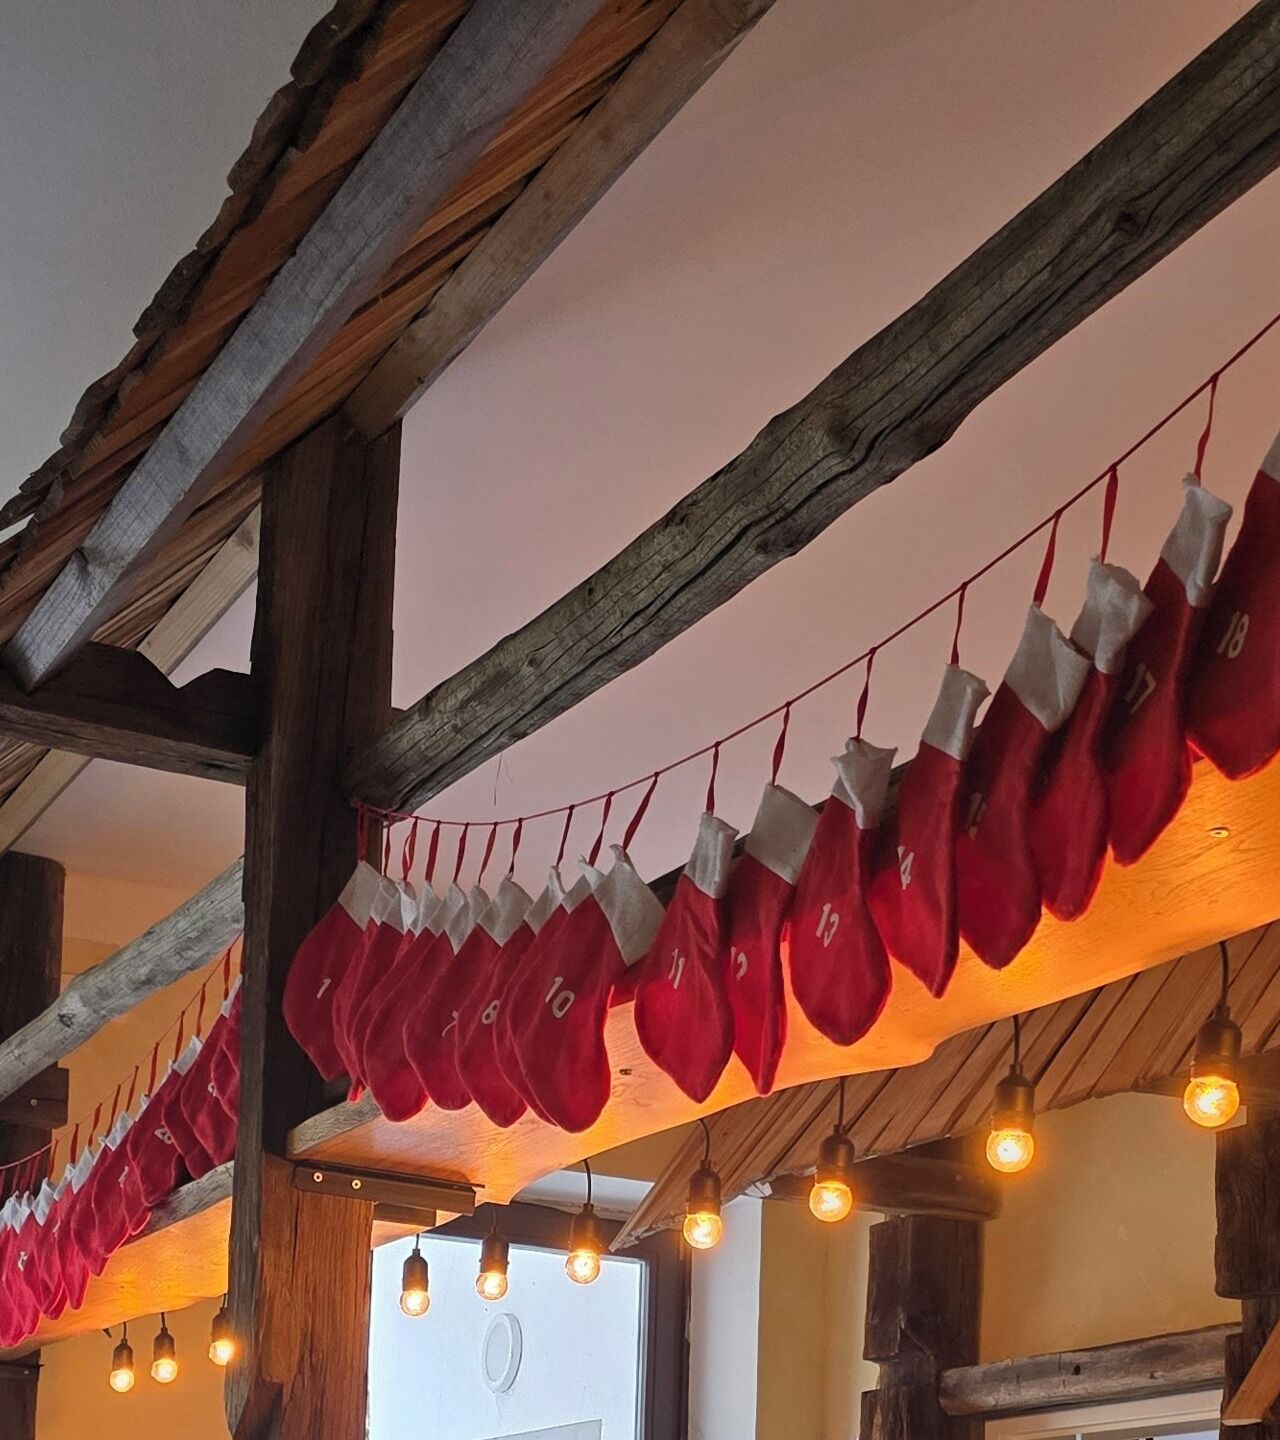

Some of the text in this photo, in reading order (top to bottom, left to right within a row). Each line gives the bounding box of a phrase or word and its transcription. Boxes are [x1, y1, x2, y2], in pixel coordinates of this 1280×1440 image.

[1217, 610, 1249, 659] 18
[316, 977, 332, 999] 1
[545, 976, 576, 1019] 10
[481, 999, 501, 1025] 8
